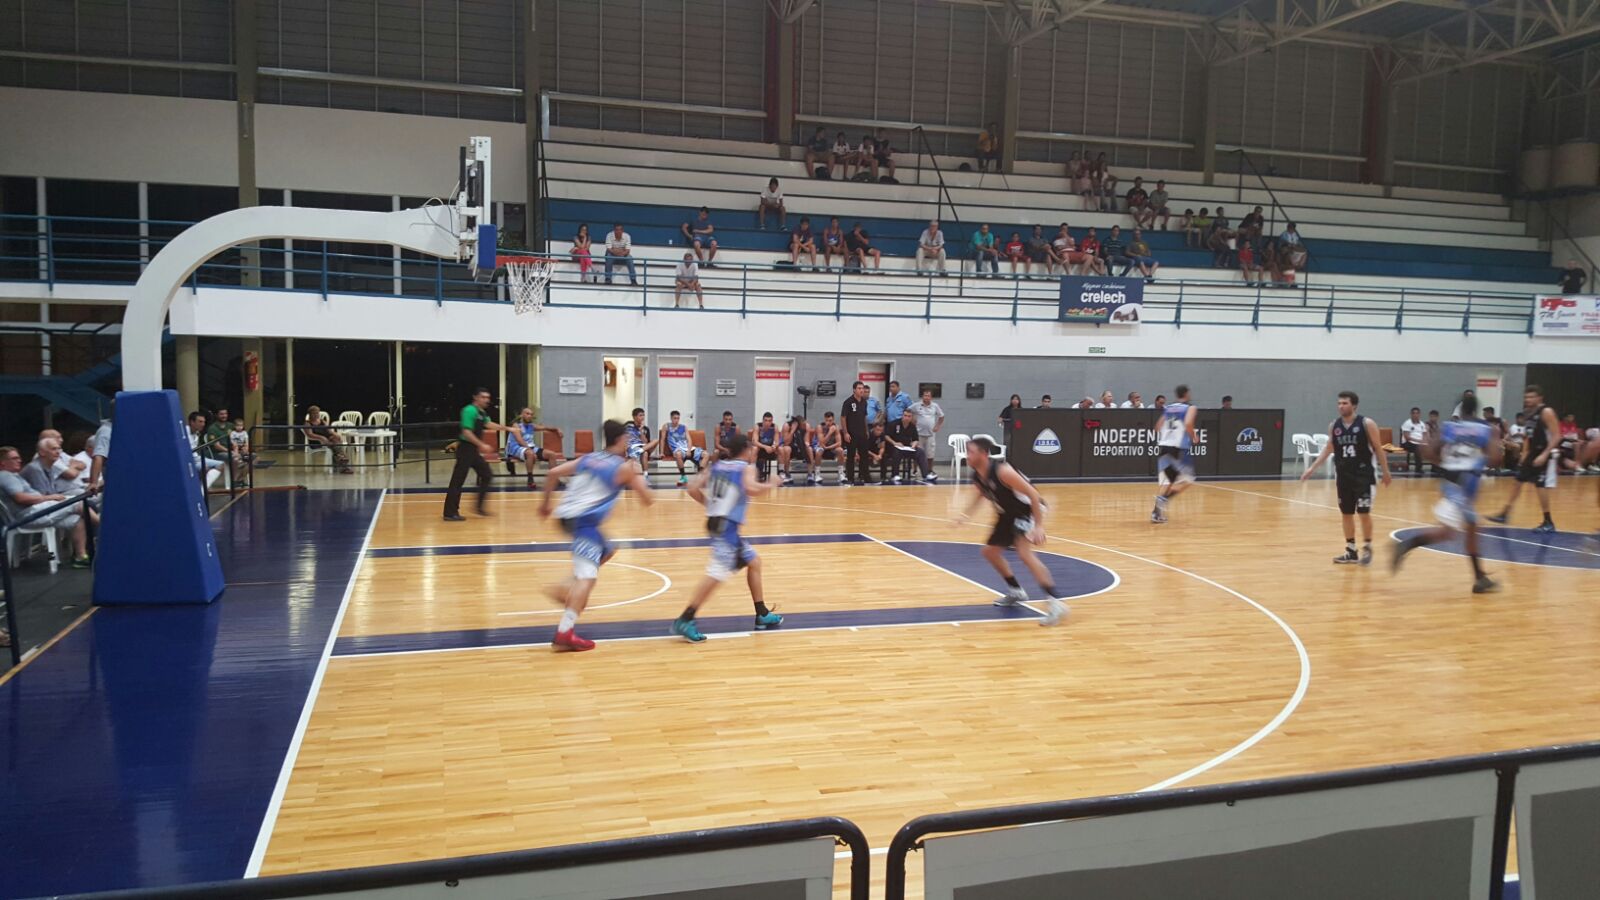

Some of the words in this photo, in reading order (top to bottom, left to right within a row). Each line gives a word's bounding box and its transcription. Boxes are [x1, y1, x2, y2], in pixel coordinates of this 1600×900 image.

[1080, 290, 1126, 303] crelech
[1093, 445, 1144, 456] DEPORTIVO
[1187, 445, 1207, 456] LUB
[1342, 445, 1356, 458] 14
